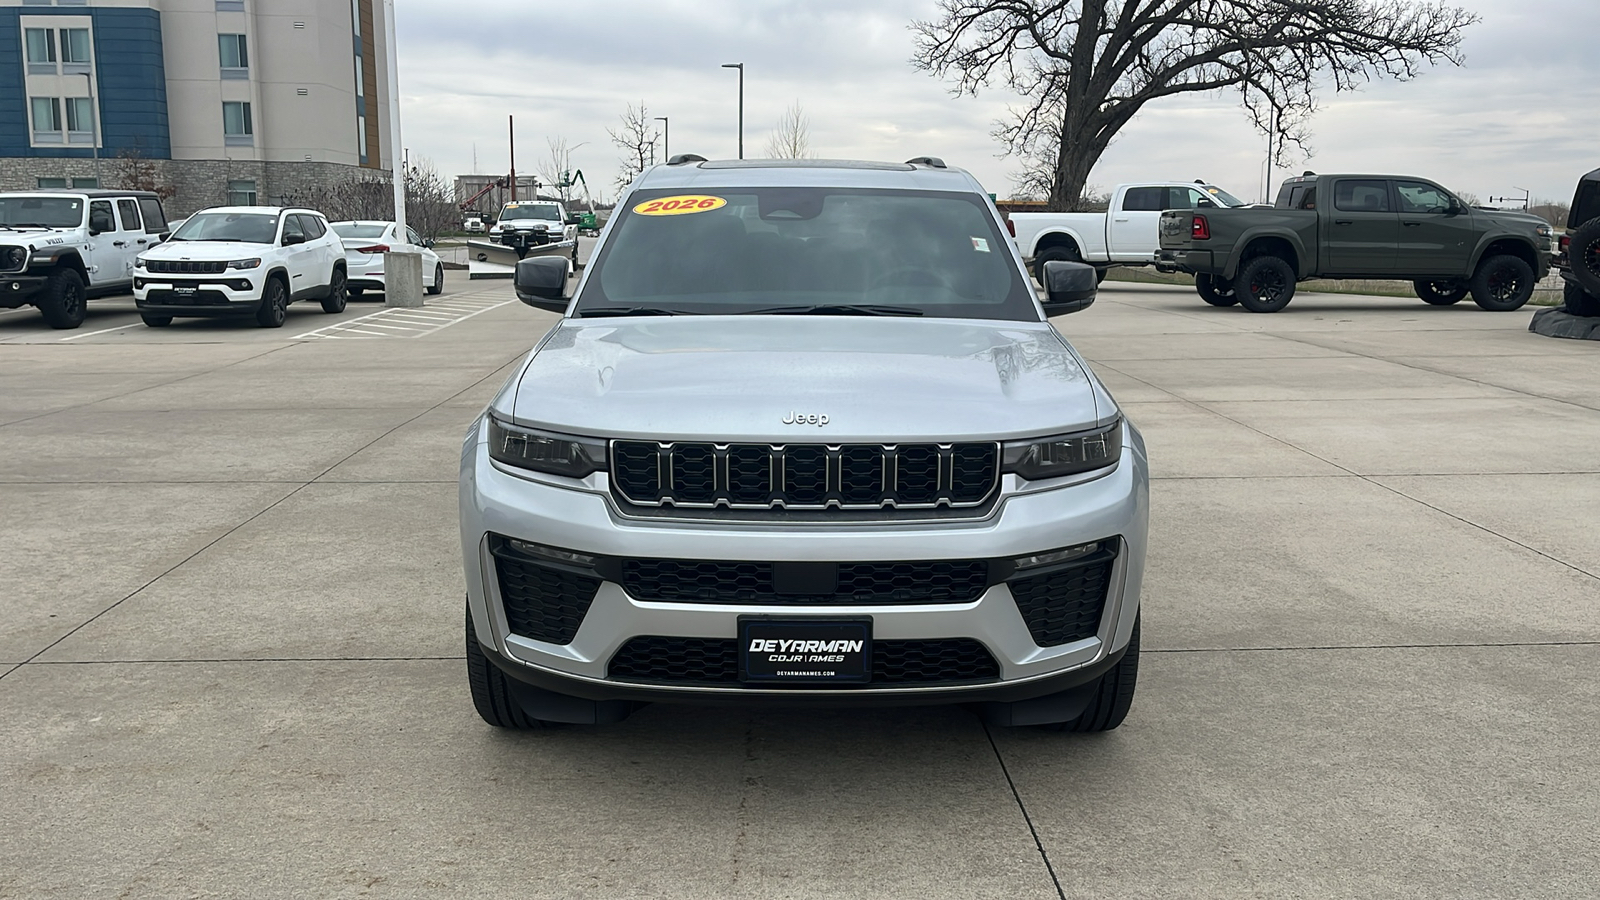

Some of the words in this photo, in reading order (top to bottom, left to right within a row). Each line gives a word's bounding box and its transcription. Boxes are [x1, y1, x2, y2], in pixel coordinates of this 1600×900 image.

[643, 198, 717, 212] 2026
[782, 411, 830, 427] Jeep
[749, 639, 863, 652] DEYARMAN
[808, 654, 845, 663] AMES
